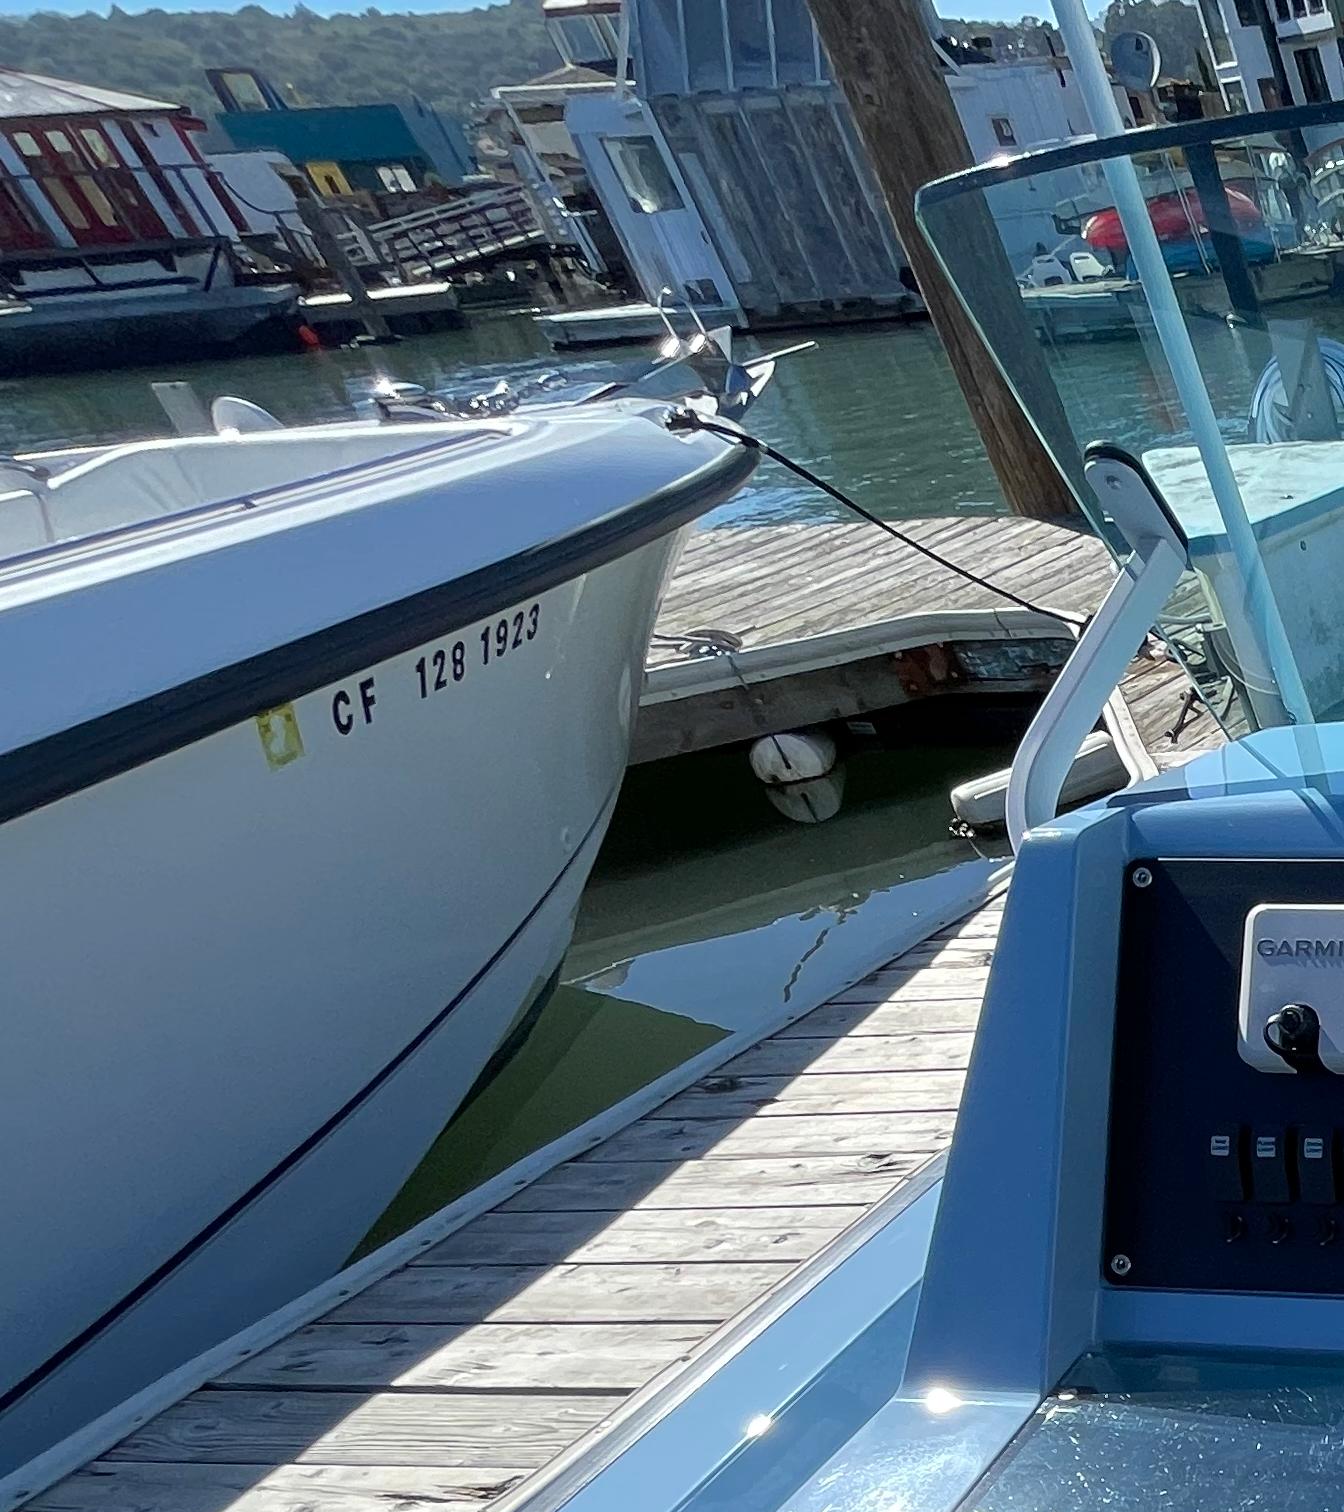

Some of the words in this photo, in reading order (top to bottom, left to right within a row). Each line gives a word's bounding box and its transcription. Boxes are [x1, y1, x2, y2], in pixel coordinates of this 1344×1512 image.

[331, 676, 378, 736] CF
[414, 640, 466, 699] 128
[480, 603, 540, 666] 1923
